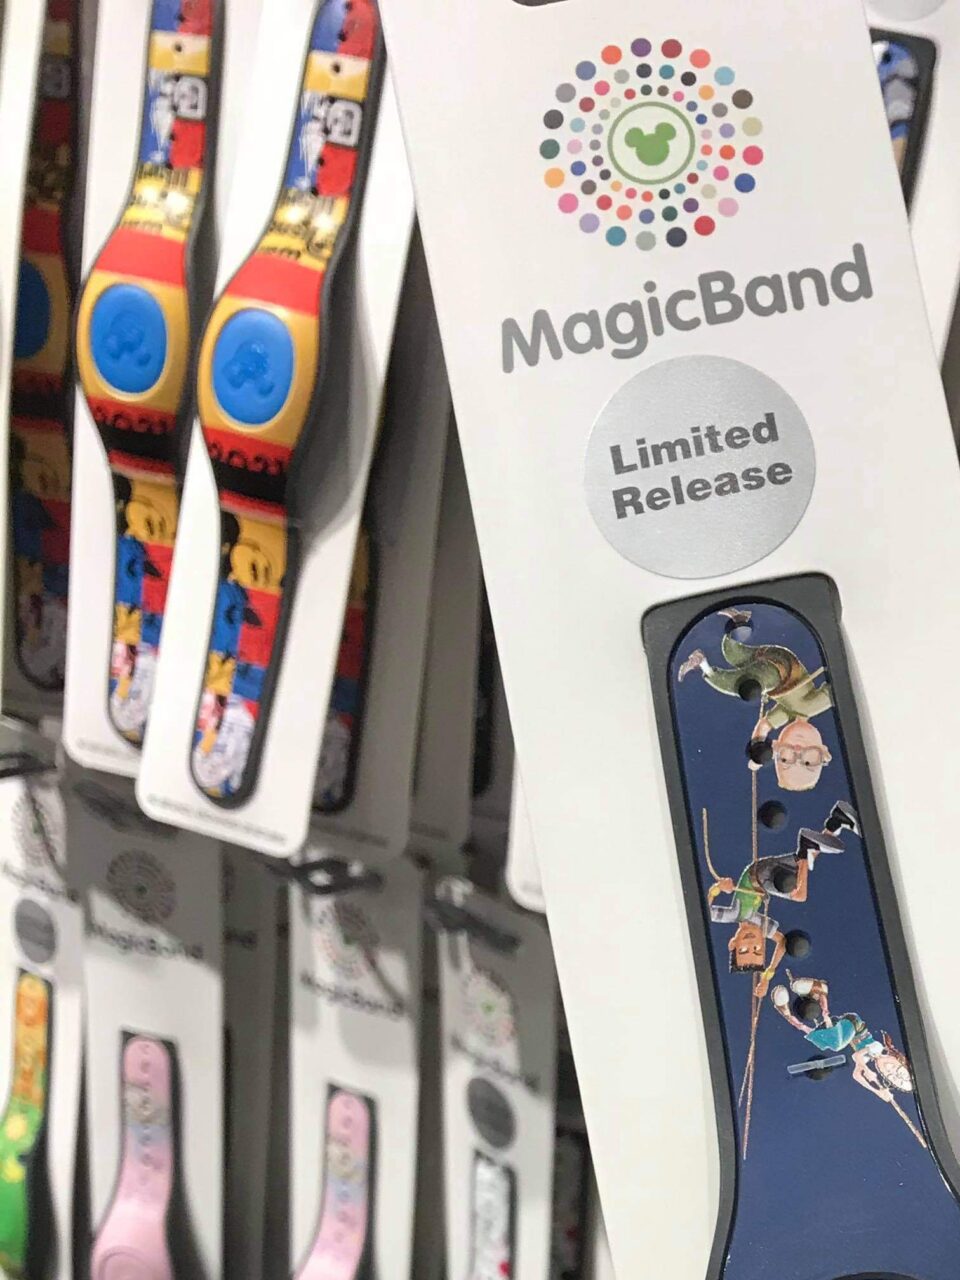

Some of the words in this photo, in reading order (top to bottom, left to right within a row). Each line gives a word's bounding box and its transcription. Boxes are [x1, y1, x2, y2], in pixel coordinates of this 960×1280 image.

[501, 243, 873, 374] MagicBand
[610, 412, 780, 475] Limited
[611, 461, 794, 520] Release
